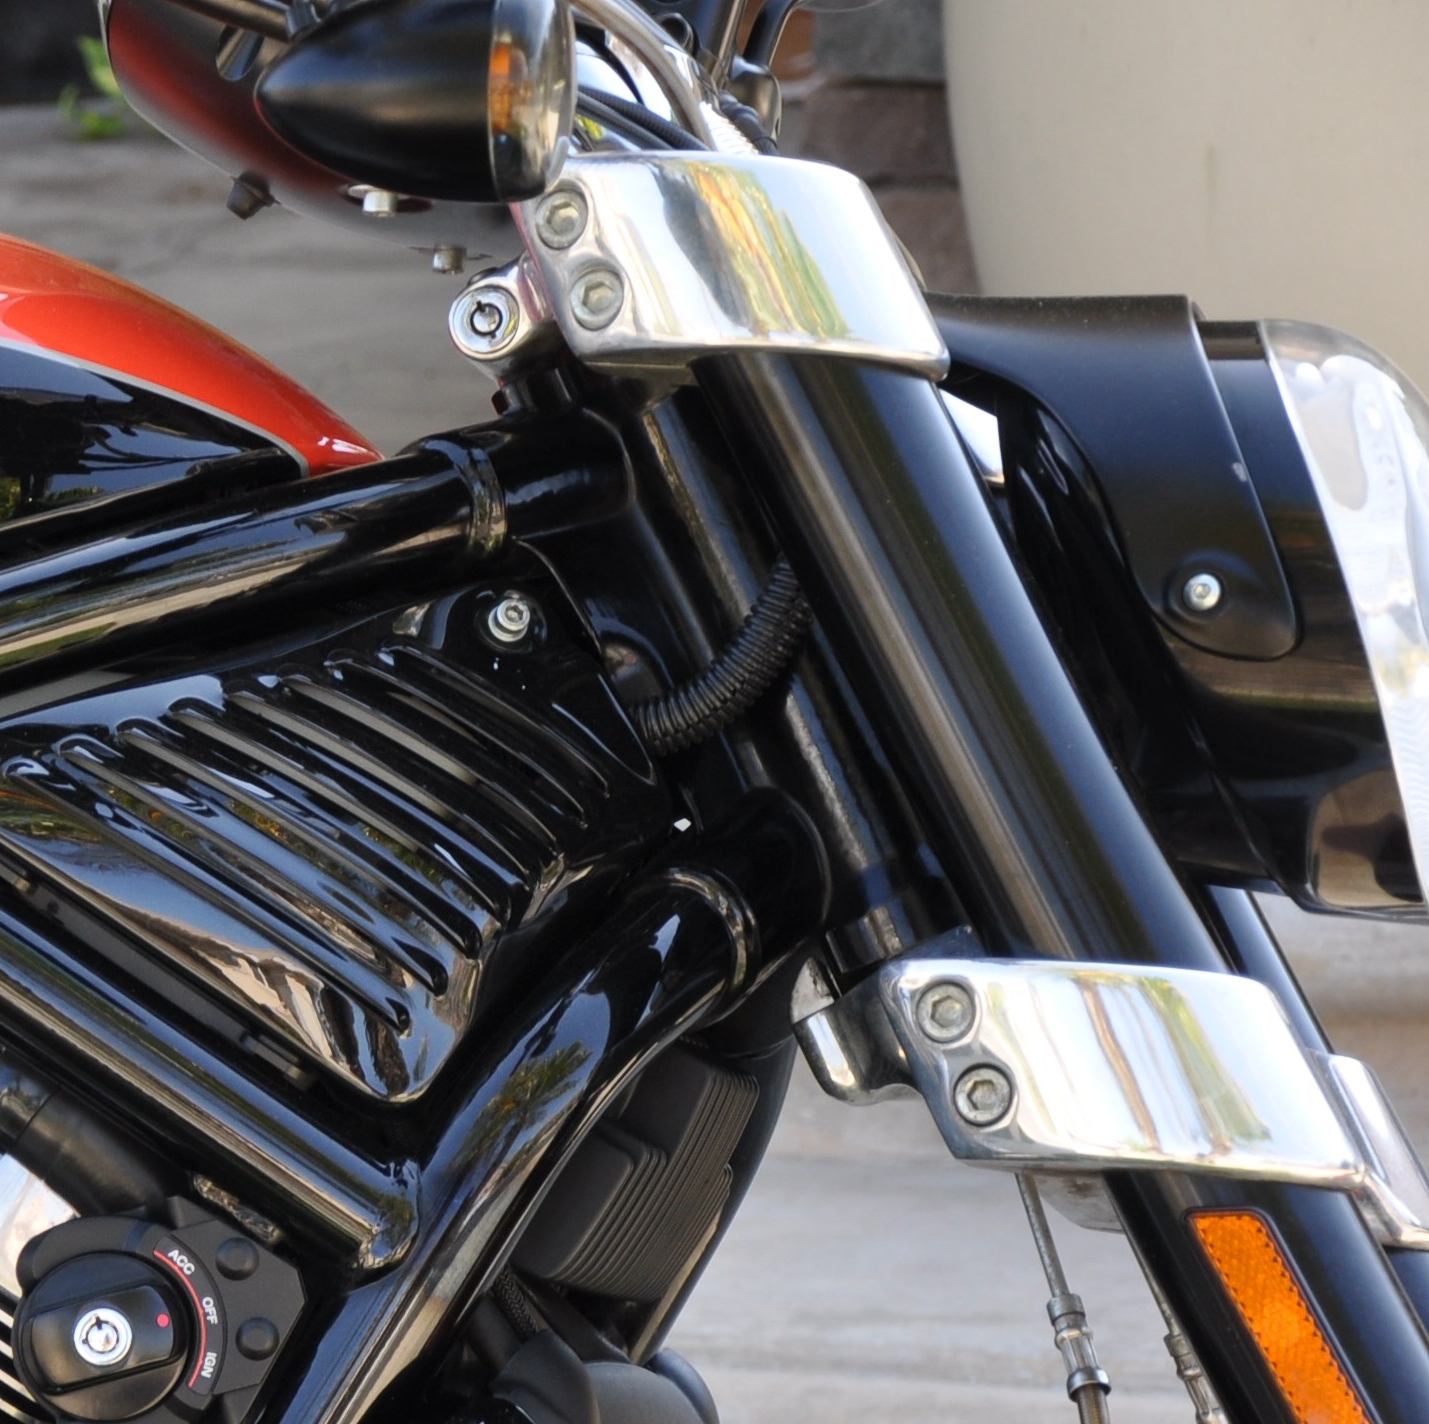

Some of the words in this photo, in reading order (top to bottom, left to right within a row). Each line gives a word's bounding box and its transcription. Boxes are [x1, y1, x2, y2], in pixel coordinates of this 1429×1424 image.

[167, 1248, 197, 1276] ACC
[201, 1295, 219, 1326] OFF
[200, 1351, 219, 1380] IGN
